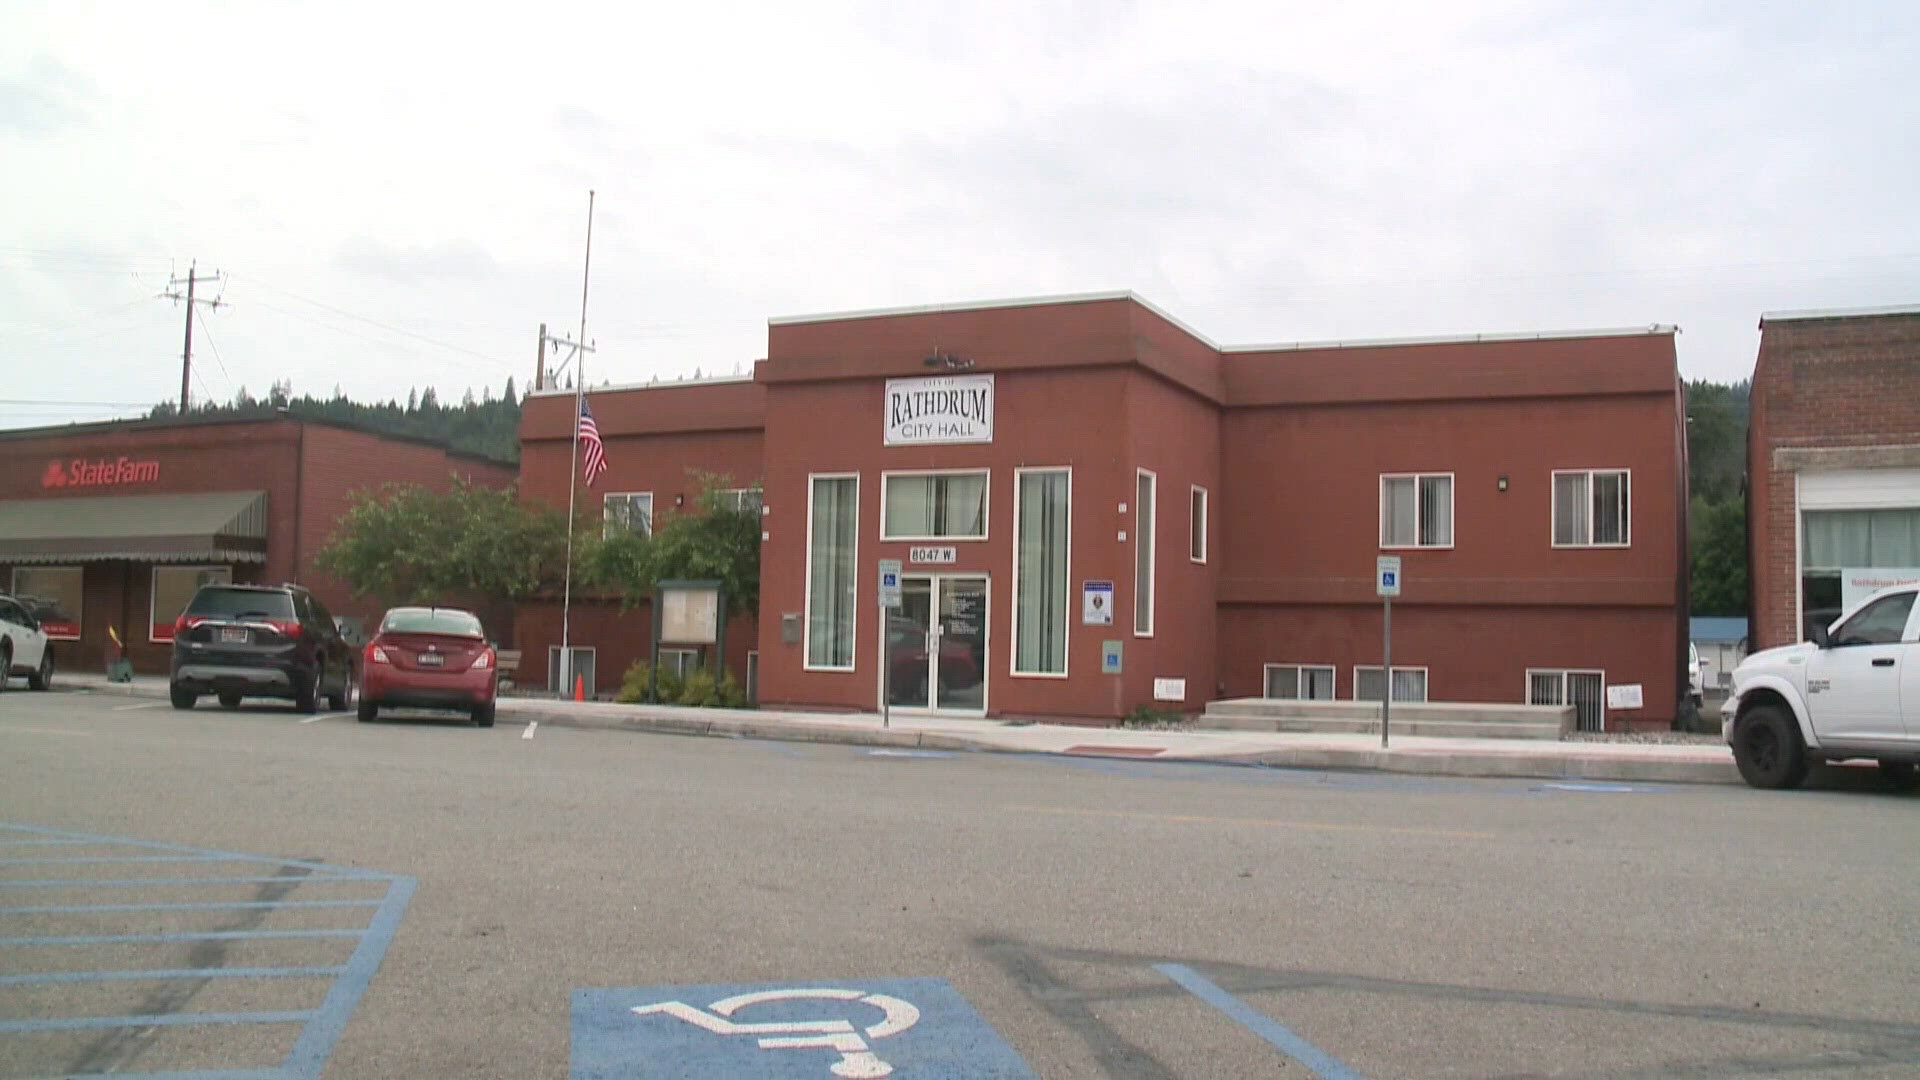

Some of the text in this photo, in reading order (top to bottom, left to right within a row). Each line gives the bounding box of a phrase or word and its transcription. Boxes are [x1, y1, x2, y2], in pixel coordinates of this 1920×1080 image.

[891, 388, 987, 428] RATHDRUM
[902, 421, 974, 438] CITY HALL
[912, 548, 939, 561] 8047
